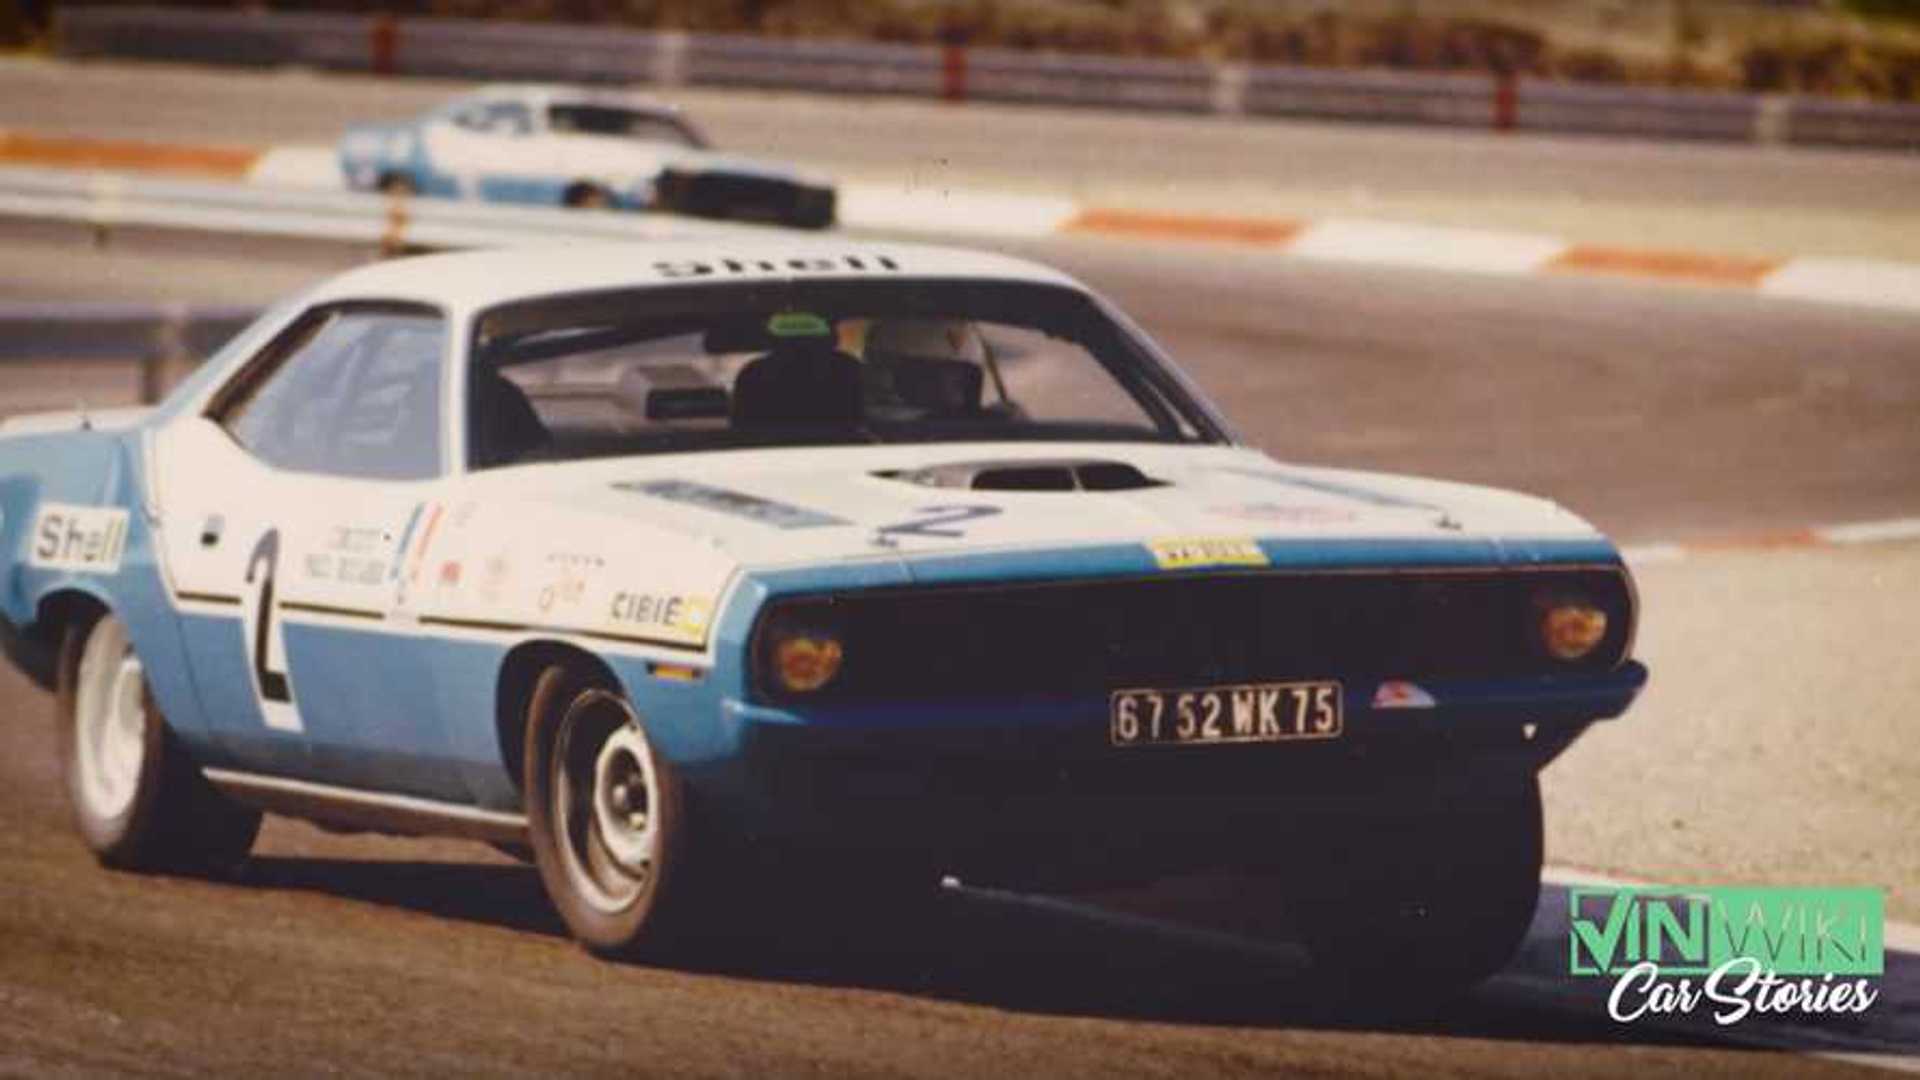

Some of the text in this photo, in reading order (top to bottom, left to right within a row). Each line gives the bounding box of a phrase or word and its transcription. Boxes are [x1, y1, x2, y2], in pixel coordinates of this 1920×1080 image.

[36, 514, 125, 562] Shell
[877, 504, 1004, 538] 2
[246, 527, 292, 704] 2
